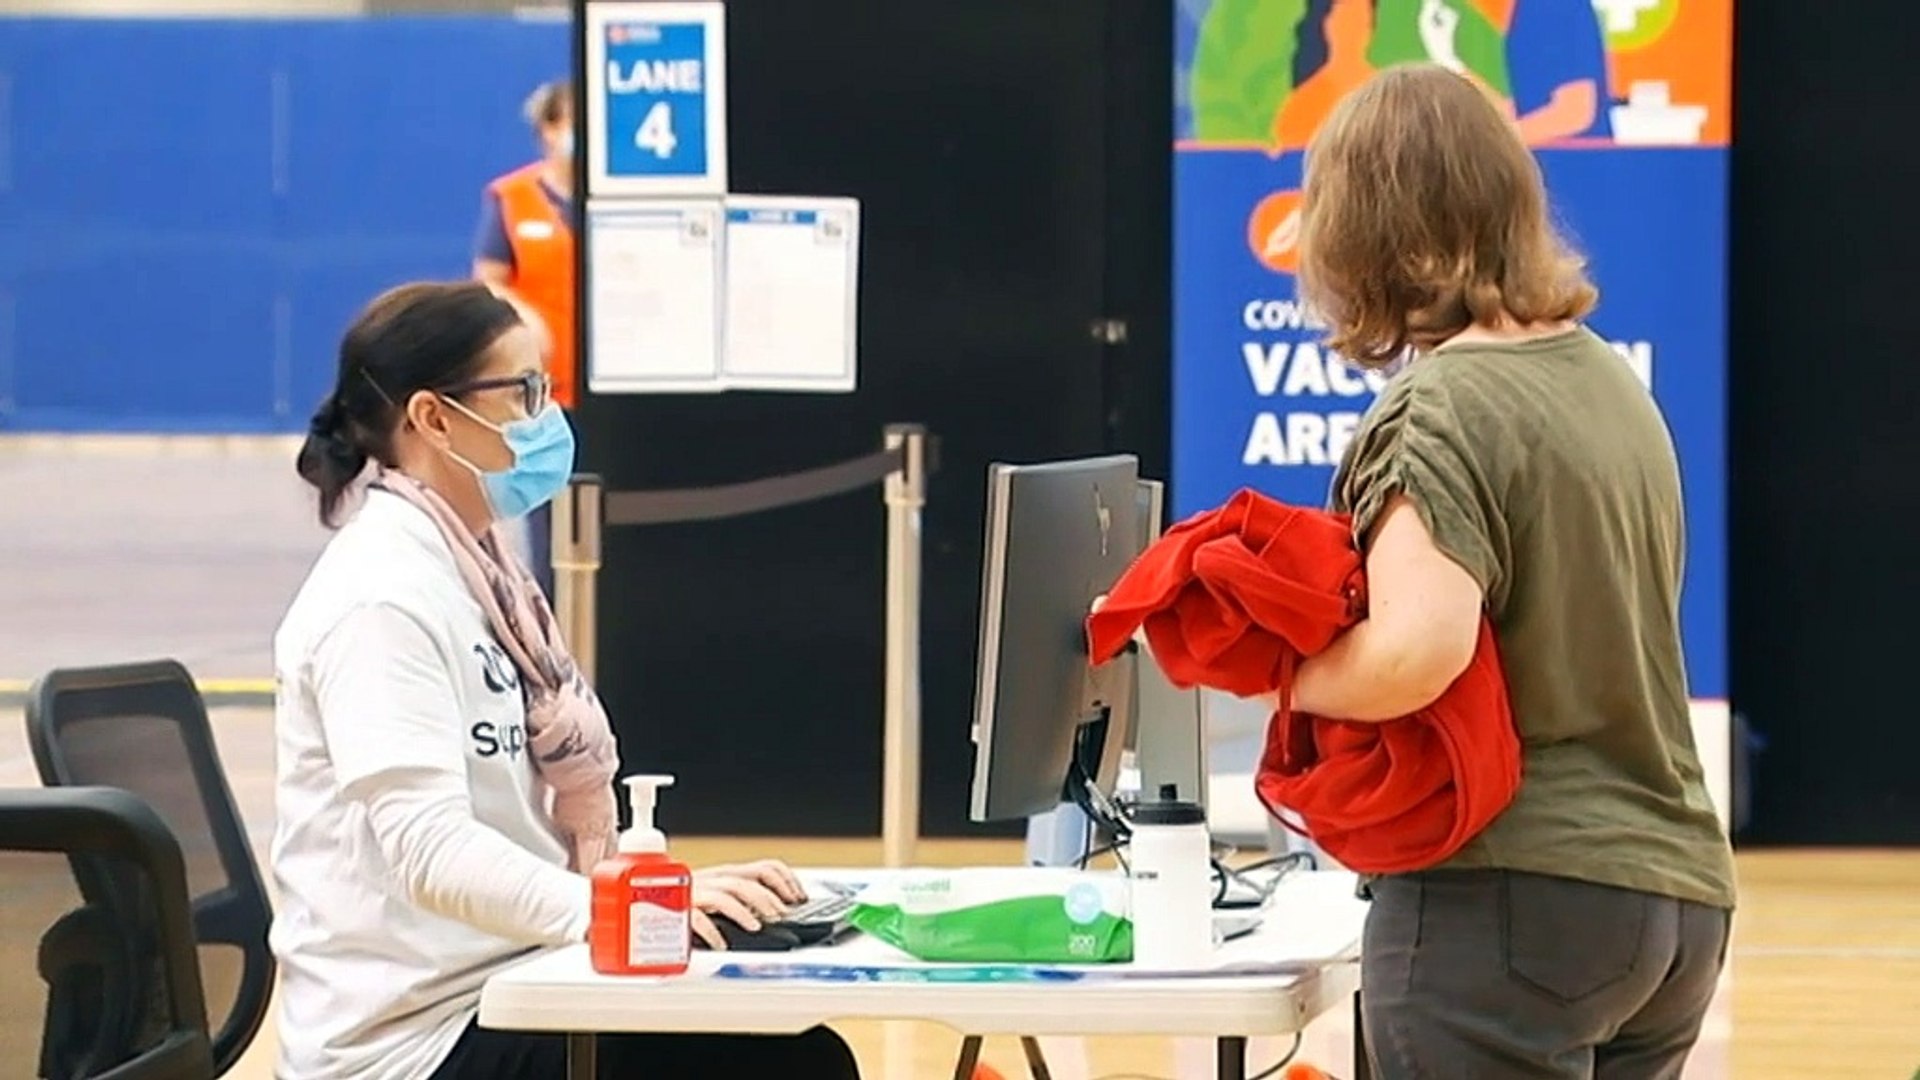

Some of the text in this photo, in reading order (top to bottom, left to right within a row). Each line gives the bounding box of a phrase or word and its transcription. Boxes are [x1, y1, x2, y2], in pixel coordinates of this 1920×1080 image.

[609, 59, 703, 94] LANE
[634, 101, 677, 159] 4
[1242, 411, 1362, 466] ARE
[471, 721, 525, 761] Sup
